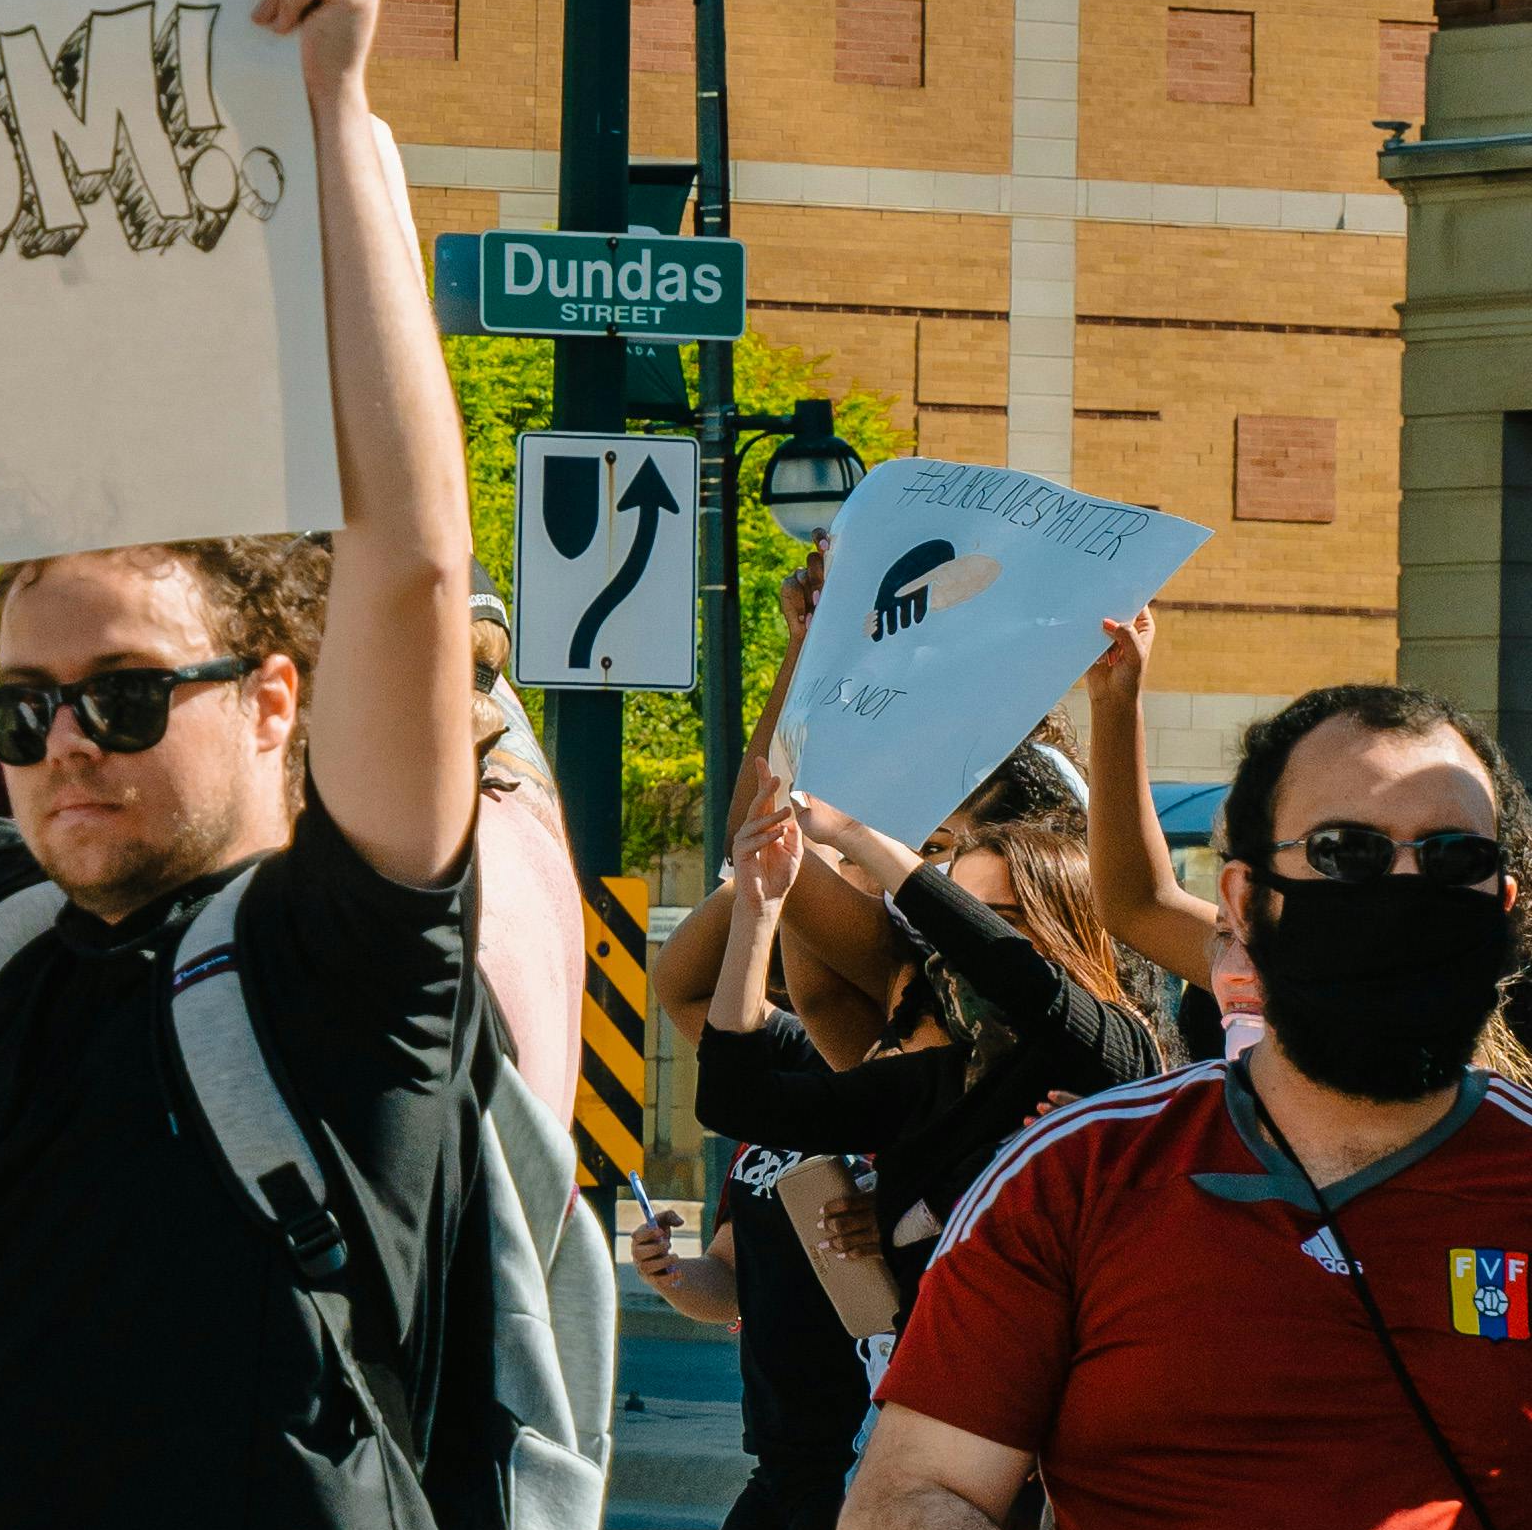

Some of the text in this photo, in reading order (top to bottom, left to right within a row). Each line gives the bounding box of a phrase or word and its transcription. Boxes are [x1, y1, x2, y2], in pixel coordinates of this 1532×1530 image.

[503, 242, 723, 304] Dundas
[560, 302, 667, 325] STREET
[842, 684, 908, 721] NOT
[1455, 1256, 1526, 1283] FVF
